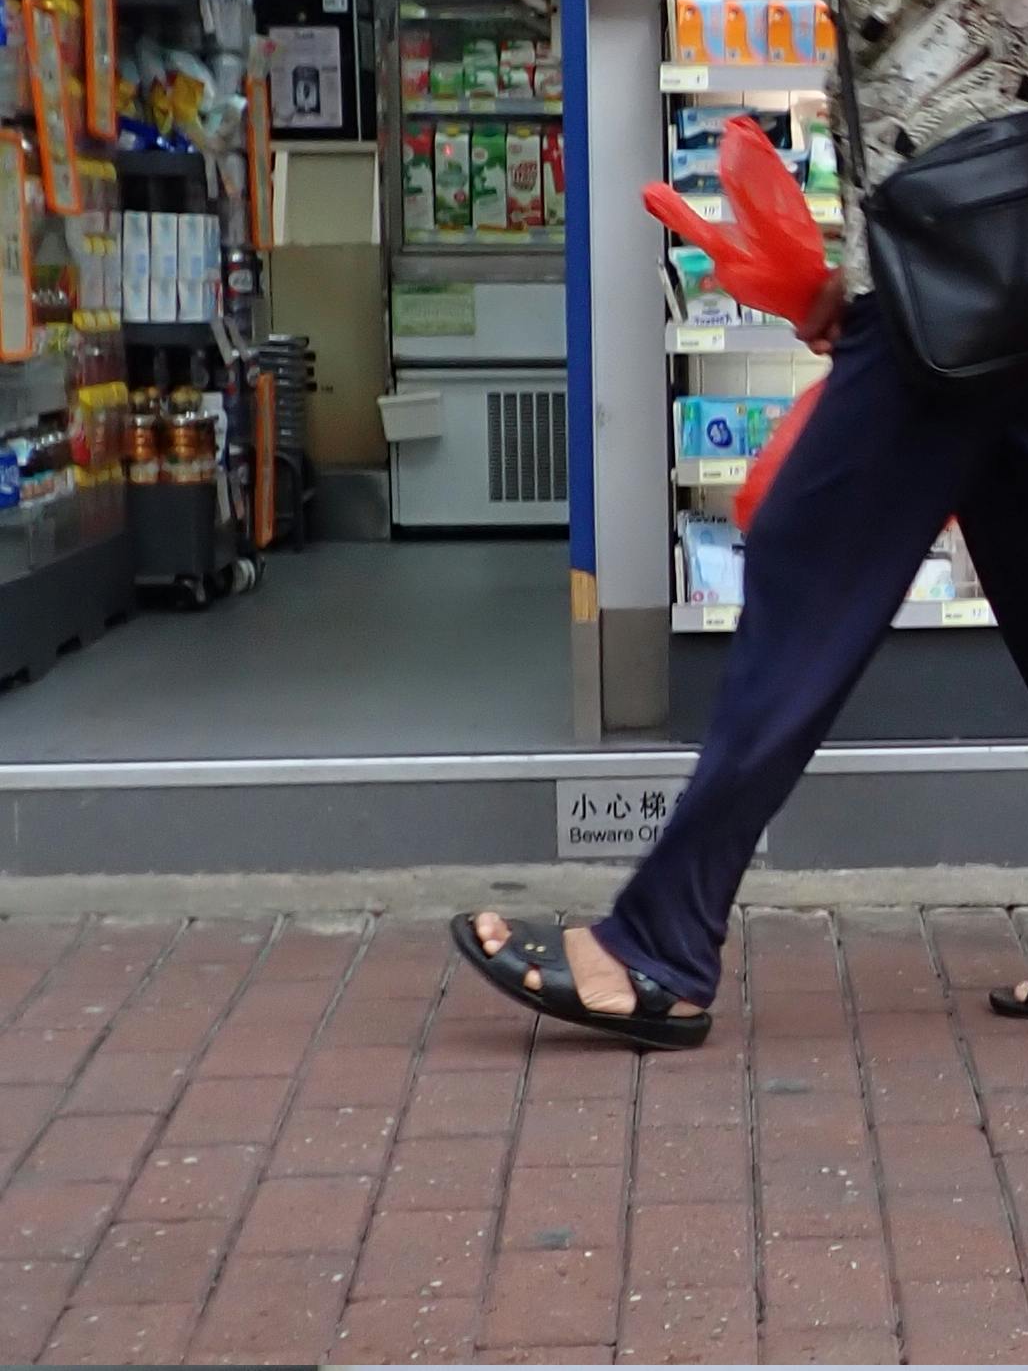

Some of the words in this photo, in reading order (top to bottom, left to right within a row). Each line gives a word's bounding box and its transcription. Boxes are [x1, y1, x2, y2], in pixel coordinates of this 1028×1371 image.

[572, 791, 684, 821] 小心梯
[569, 827, 634, 843] Beware
